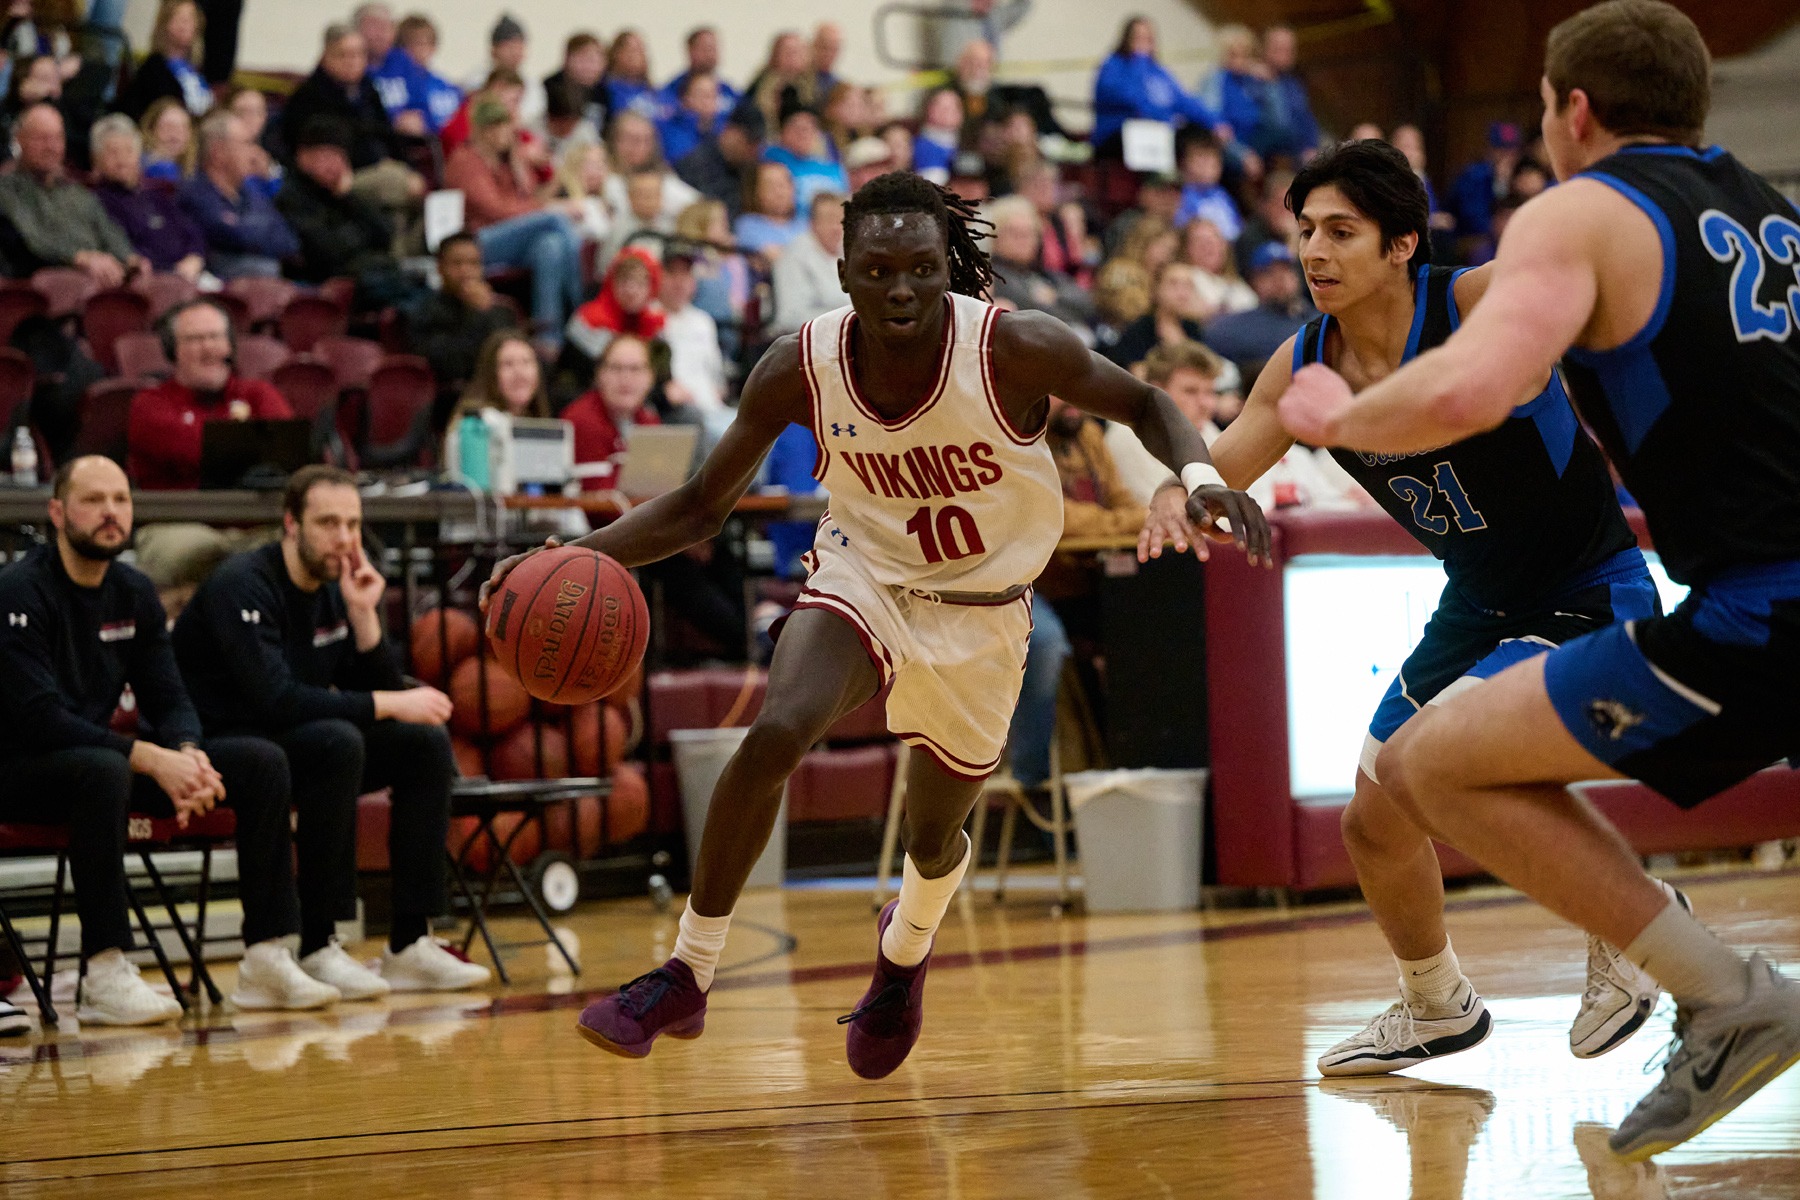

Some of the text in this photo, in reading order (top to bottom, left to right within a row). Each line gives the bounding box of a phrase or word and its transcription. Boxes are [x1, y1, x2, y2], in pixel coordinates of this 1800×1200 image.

[839, 441, 1003, 500] VIKINGS
[1387, 460, 1488, 535] 21
[906, 504, 986, 564] 10
[535, 579, 587, 683] SPALDING
